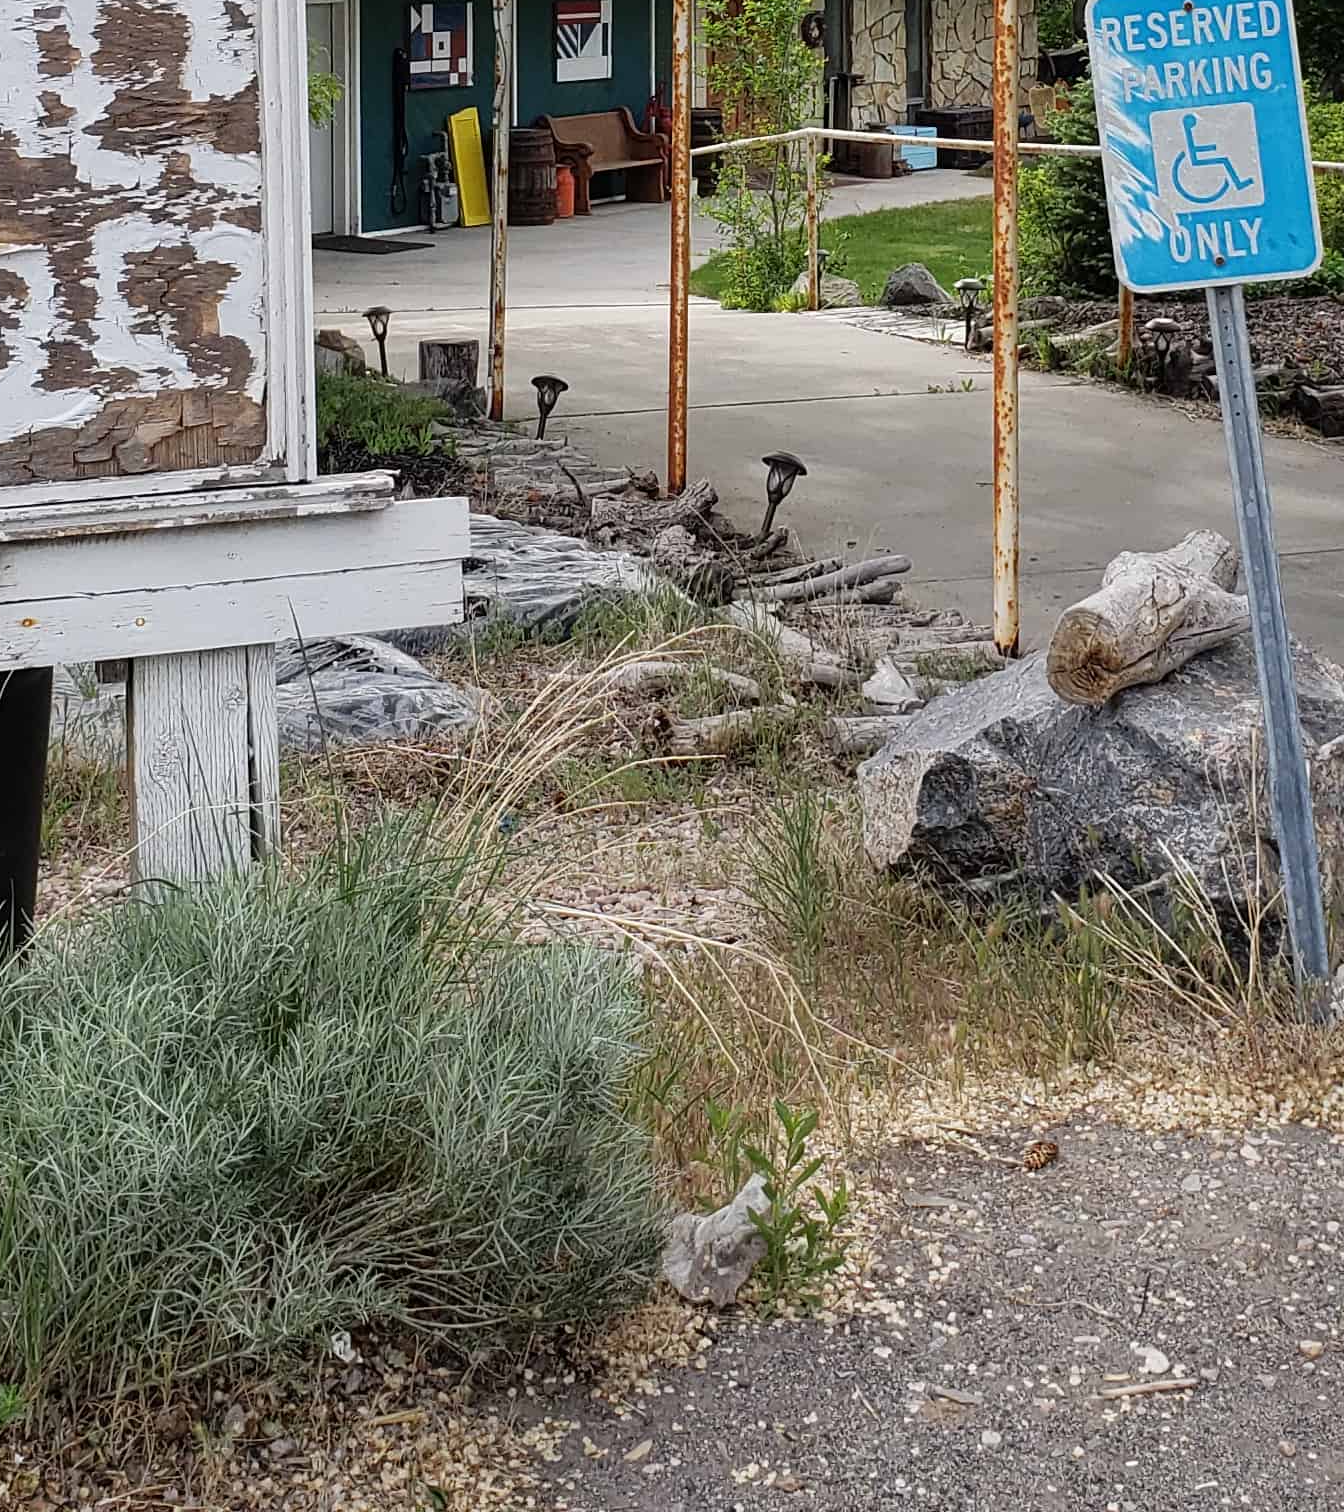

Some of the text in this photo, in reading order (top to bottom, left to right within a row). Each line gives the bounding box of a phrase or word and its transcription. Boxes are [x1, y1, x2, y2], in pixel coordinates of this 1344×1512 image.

[1099, 0, 1281, 53] RESERVED
[1121, 51, 1272, 104] PARKING
[1168, 216, 1264, 264] ONLY
